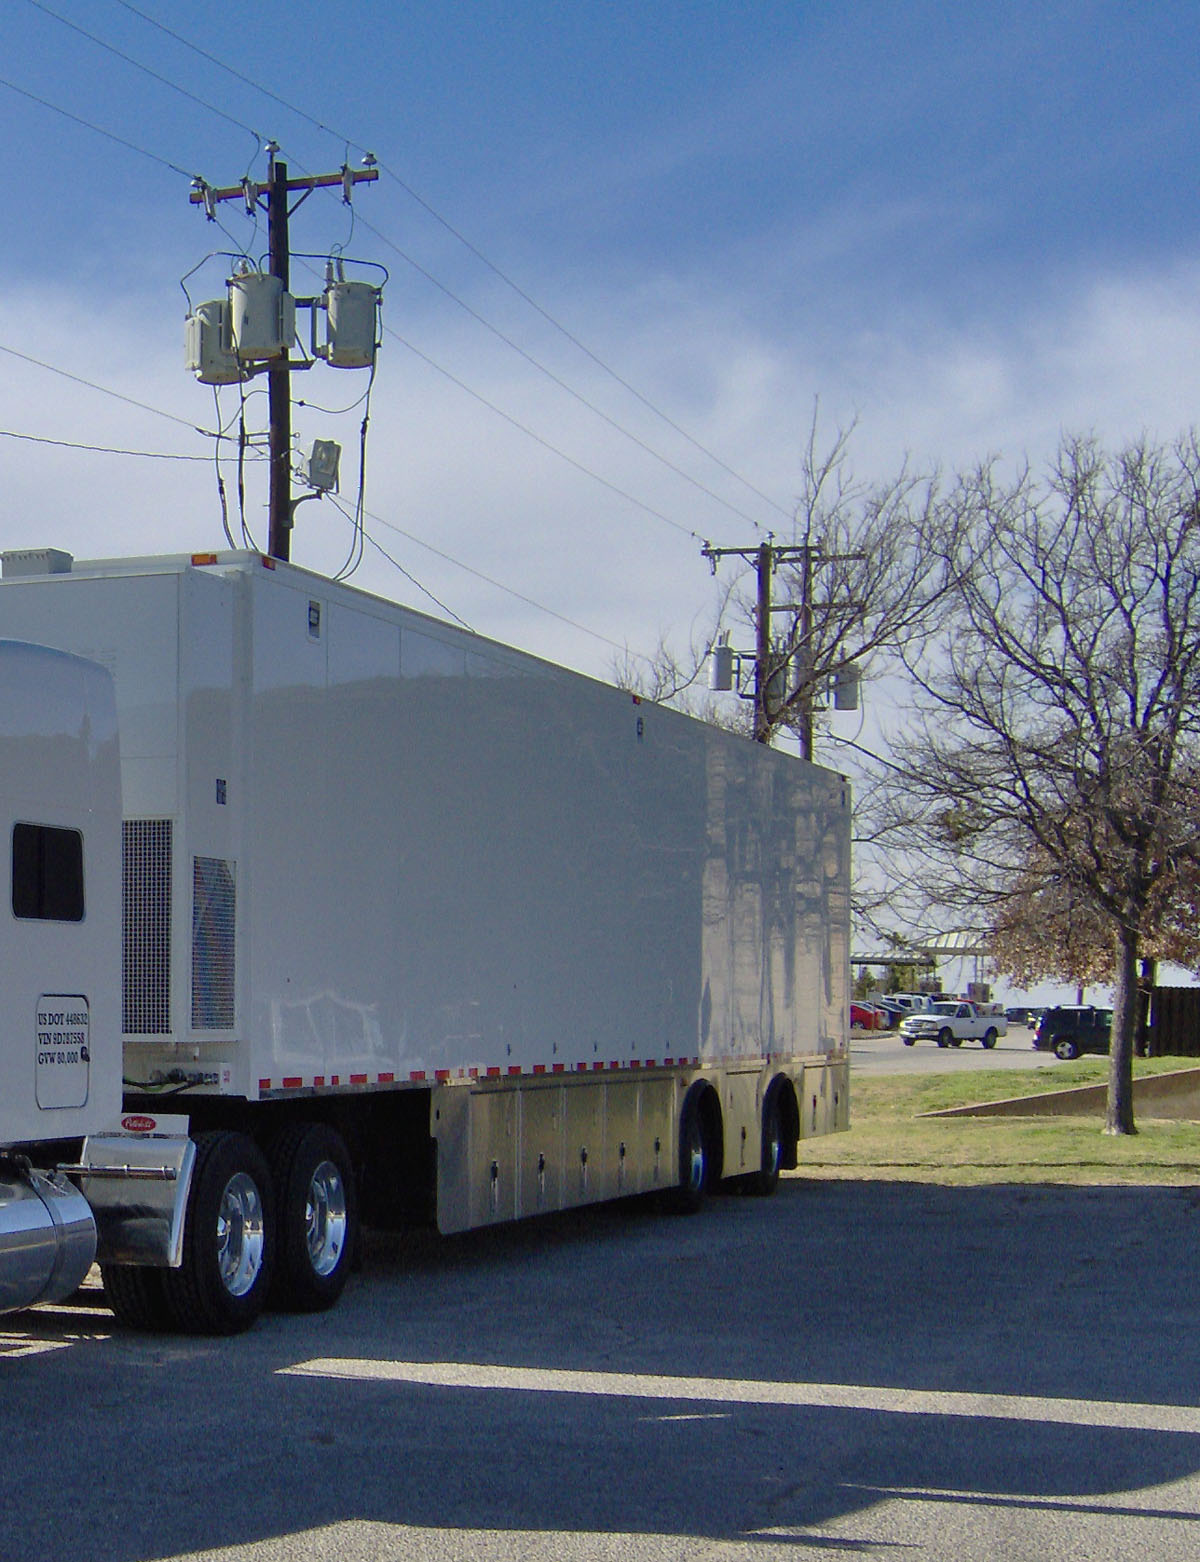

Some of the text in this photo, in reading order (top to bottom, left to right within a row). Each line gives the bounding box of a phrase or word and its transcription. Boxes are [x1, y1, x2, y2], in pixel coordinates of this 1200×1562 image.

[48, 1013, 64, 1025] DOT
[38, 1032, 51, 1045] VIN
[38, 1052, 56, 1065] GVW
